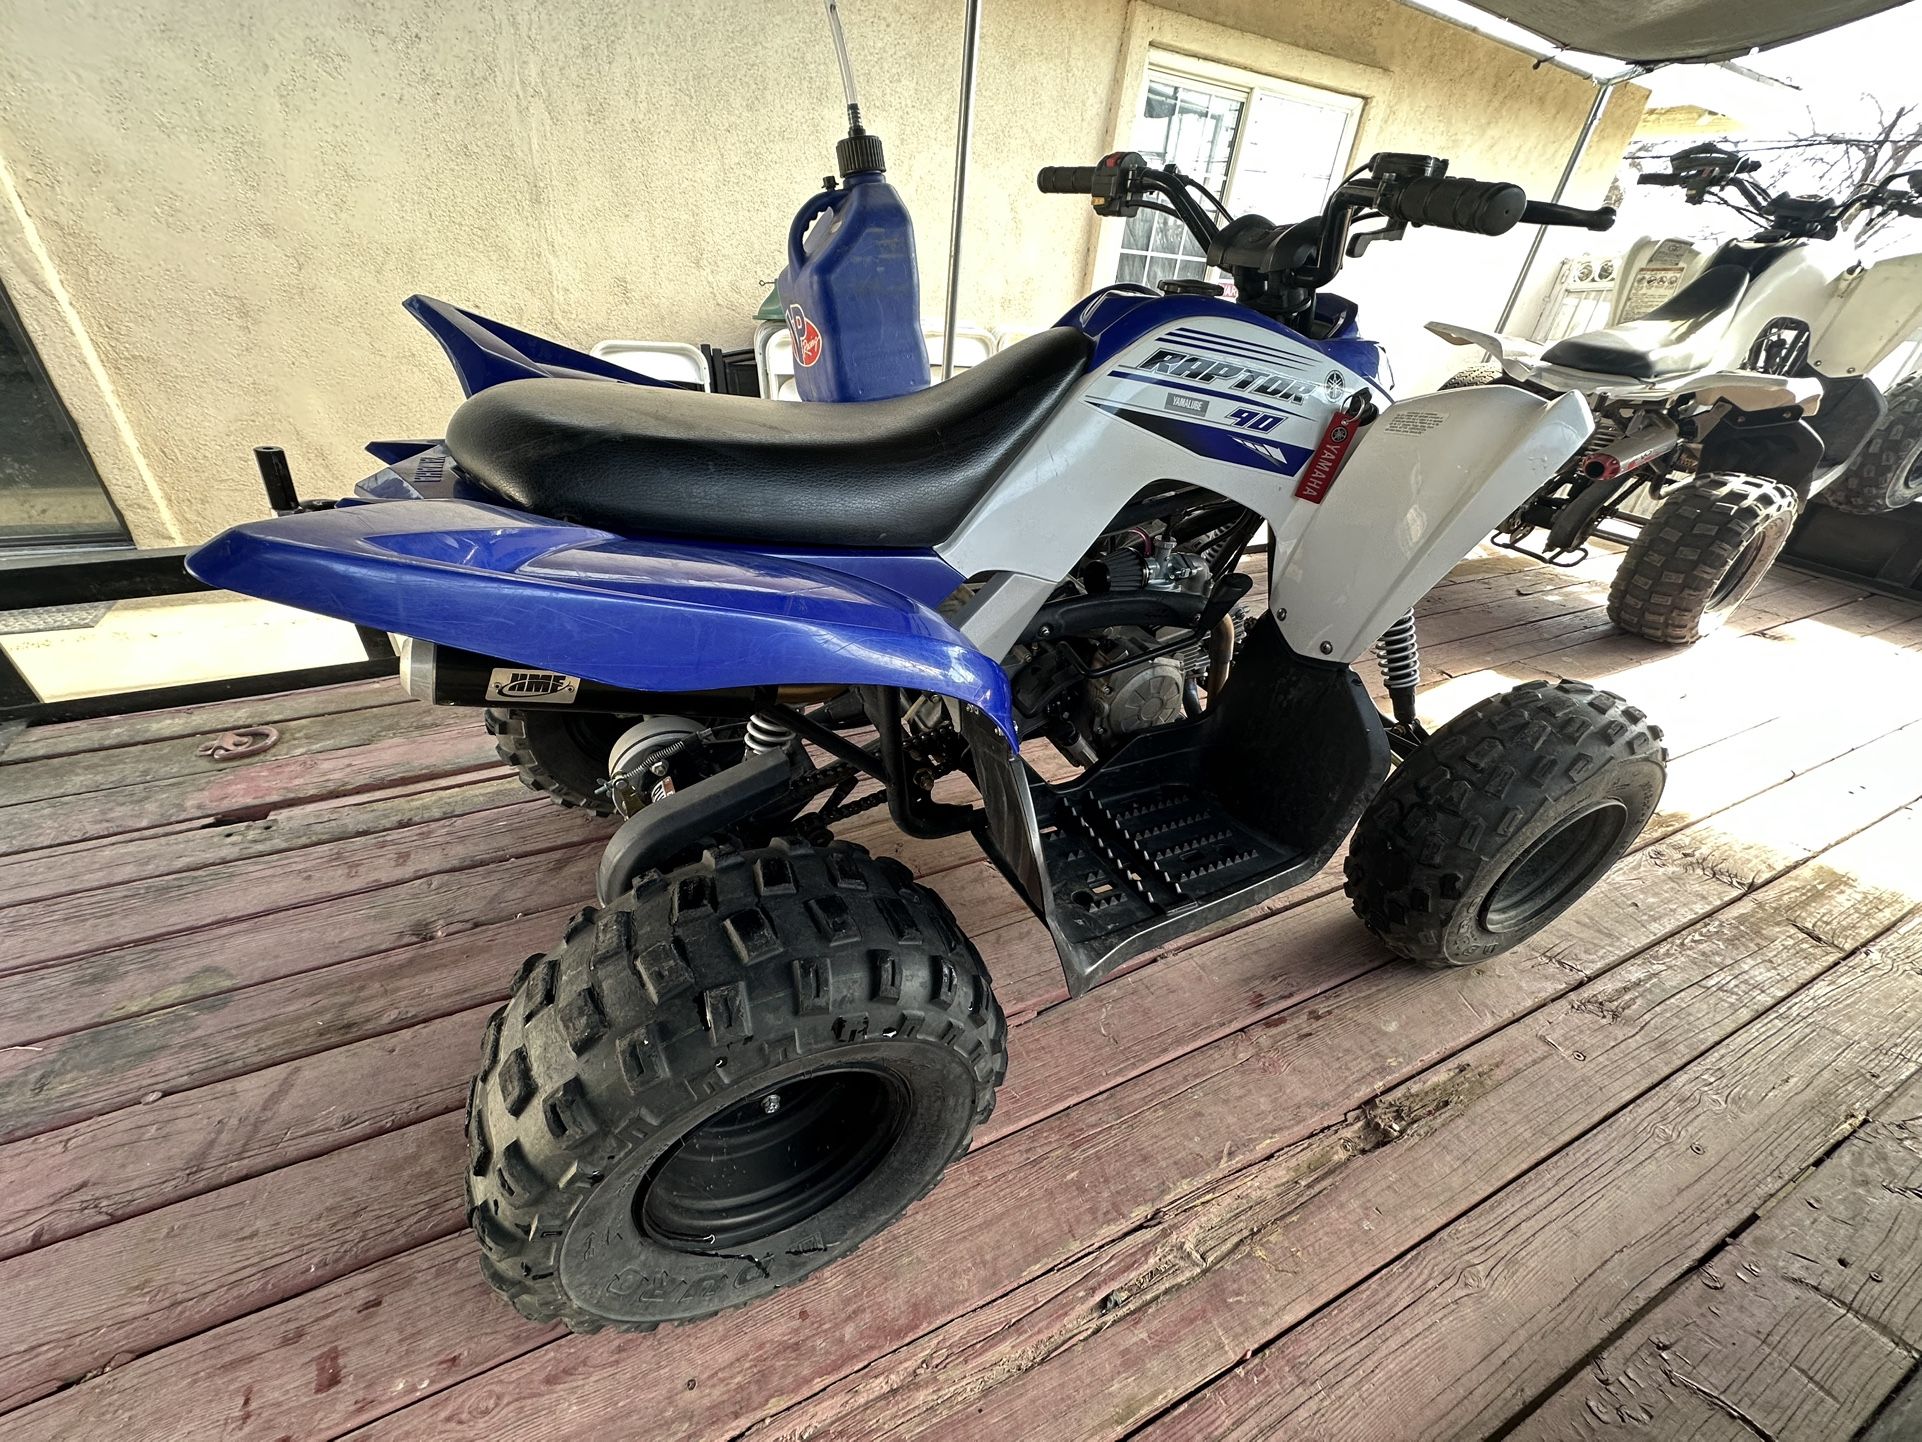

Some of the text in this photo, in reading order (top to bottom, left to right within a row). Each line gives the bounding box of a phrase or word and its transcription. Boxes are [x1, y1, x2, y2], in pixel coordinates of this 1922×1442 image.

[1137, 349, 1319, 406] RAPTOR
[1172, 395, 1203, 411] YAMALUBE
[1226, 407, 1287, 434] 90
[1303, 444, 1340, 496] YAMAHA
[510, 672, 567, 693] HMF
